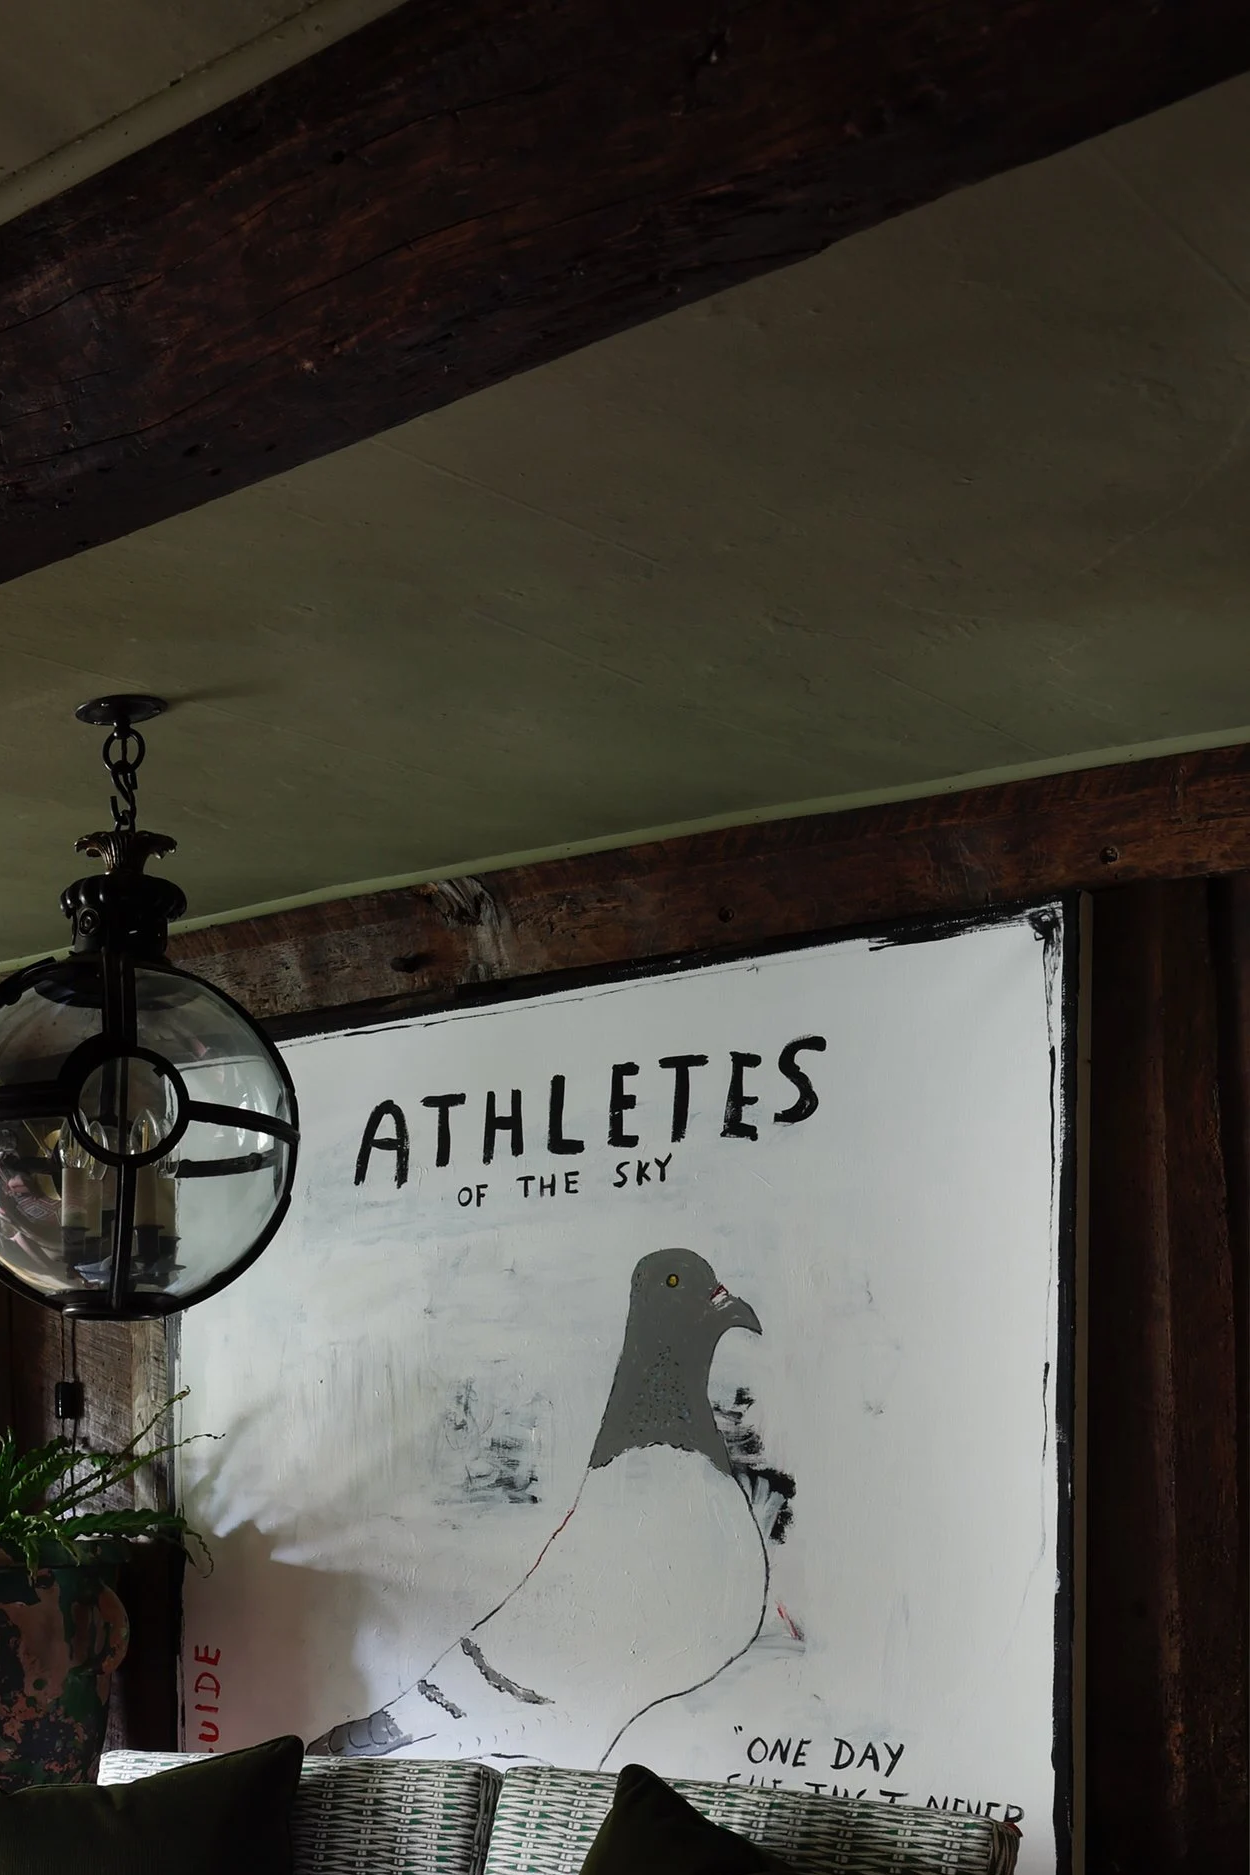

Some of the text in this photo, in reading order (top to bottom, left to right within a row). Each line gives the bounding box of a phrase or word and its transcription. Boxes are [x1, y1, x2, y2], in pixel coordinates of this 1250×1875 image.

[354, 1035, 827, 1188] ATHLETES
[457, 1152, 673, 1208] OF THE SKY
[194, 1644, 221, 1752] UIDE
[830, 1737, 905, 1778] DAY
